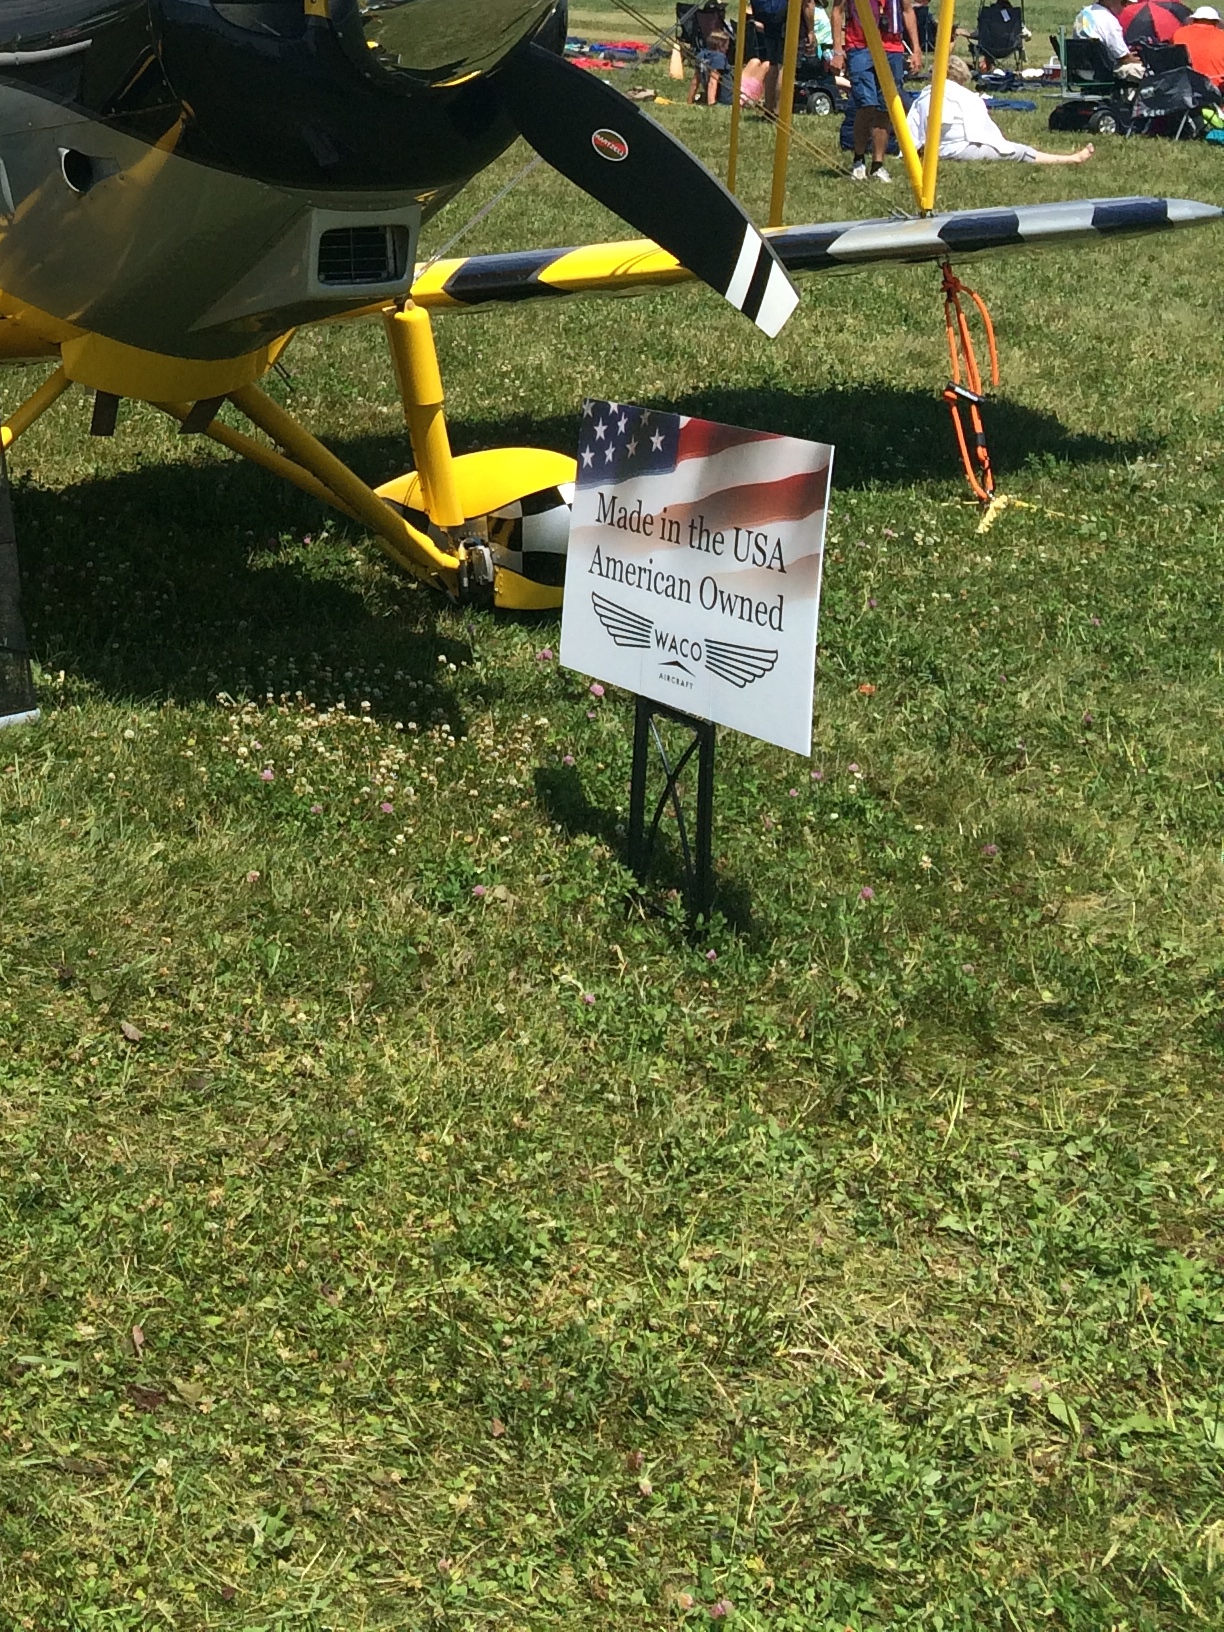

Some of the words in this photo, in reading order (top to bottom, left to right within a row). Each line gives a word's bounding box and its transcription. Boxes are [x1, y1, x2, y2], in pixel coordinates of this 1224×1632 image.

[595, 133, 625, 157] HARTZELL
[595, 491, 654, 537] Made
[659, 506, 682, 546] in
[688, 514, 725, 556] the
[733, 527, 788, 574] USA
[588, 545, 692, 605] American
[699, 576, 784, 632] Owned
[654, 628, 703, 662] WACO
[658, 672, 694, 690] AIRCRAFT
